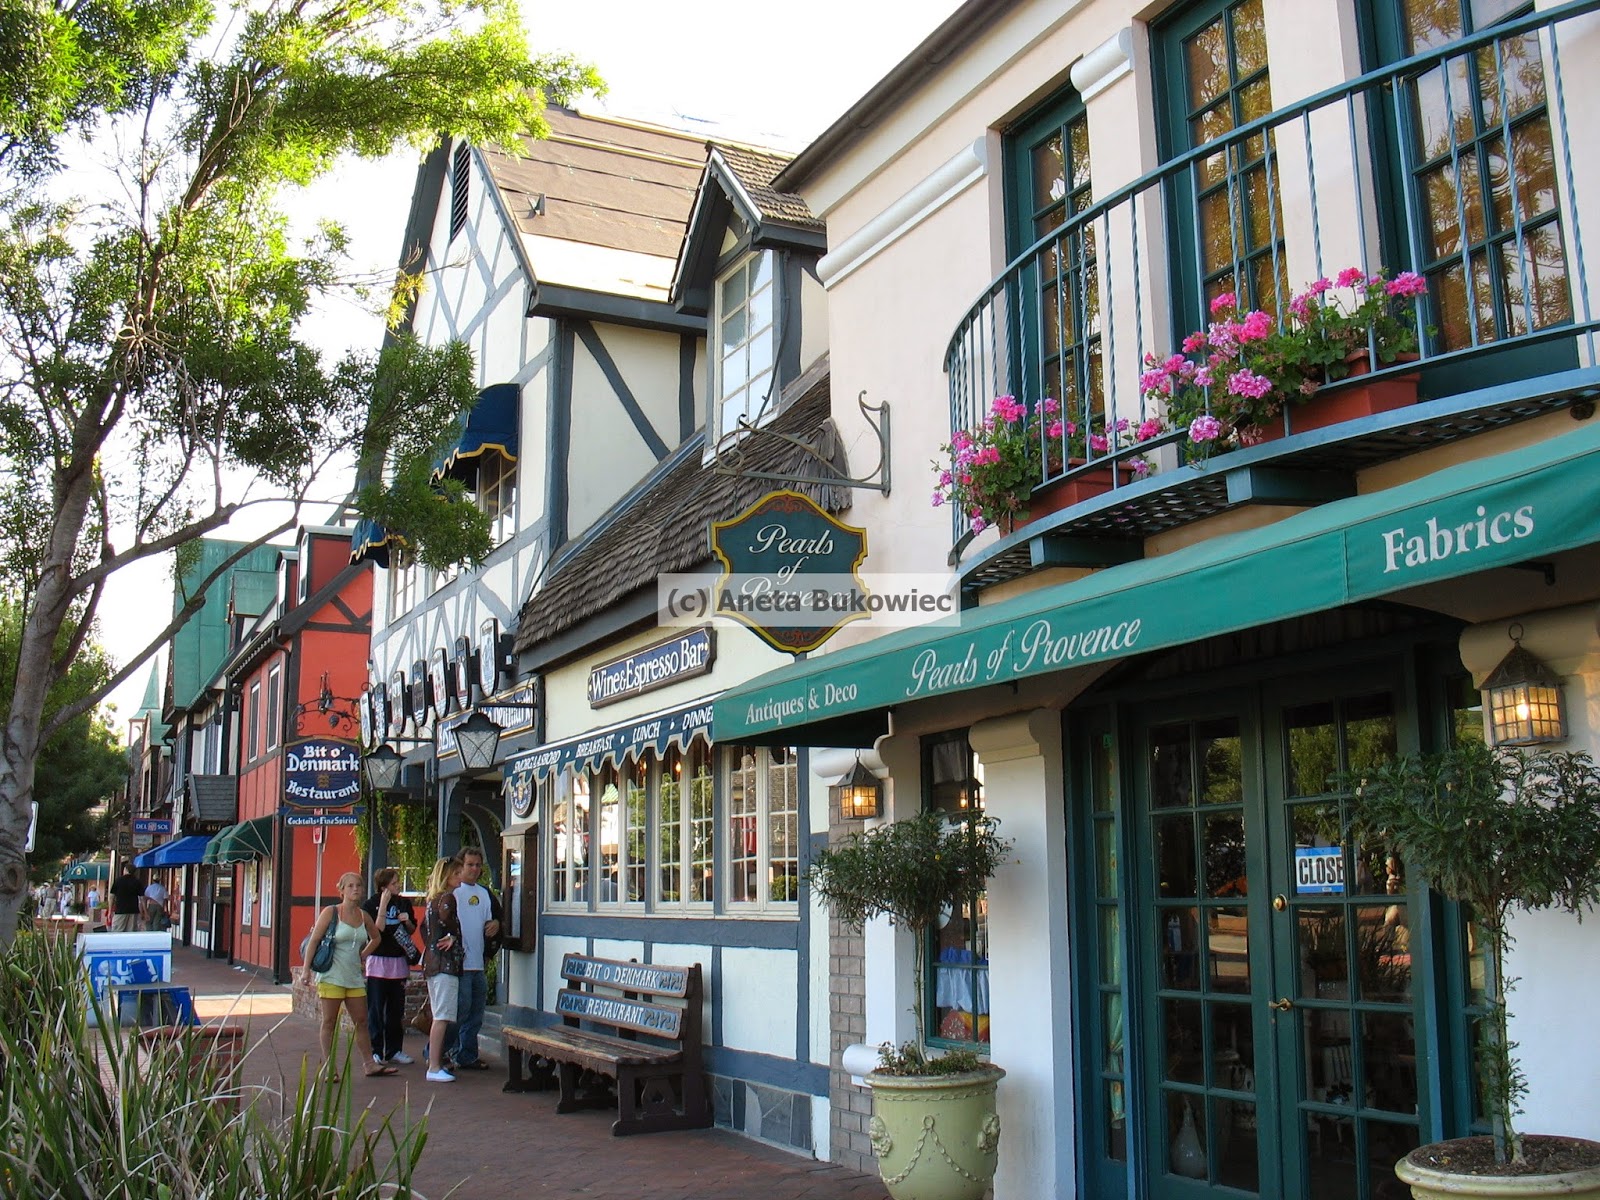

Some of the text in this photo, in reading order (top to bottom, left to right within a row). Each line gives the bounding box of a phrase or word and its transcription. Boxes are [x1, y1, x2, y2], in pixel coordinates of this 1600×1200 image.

[748, 523, 835, 555] Pearls
[1381, 505, 1535, 574] Fabrics
[777, 556, 809, 586] of
[680, 639, 705, 672] Bar
[906, 618, 1142, 697] Pearls of Provence
[745, 683, 858, 726] Antiques & Deco
[575, 734, 616, 759] BREAKFAST
[632, 720, 662, 744] LUNCH
[682, 704, 714, 731] DINNE
[286, 752, 360, 772] Denmark
[303, 745, 345, 758] Bit o'
[286, 780, 360, 800] Restaurant
[287, 816, 317, 825] Cocktails
[1298, 856, 1345, 885] CLOSE
[584, 961, 602, 981] BIT
[613, 966, 660, 989] DENMARK
[586, 998, 645, 1023] RESTAURANT
